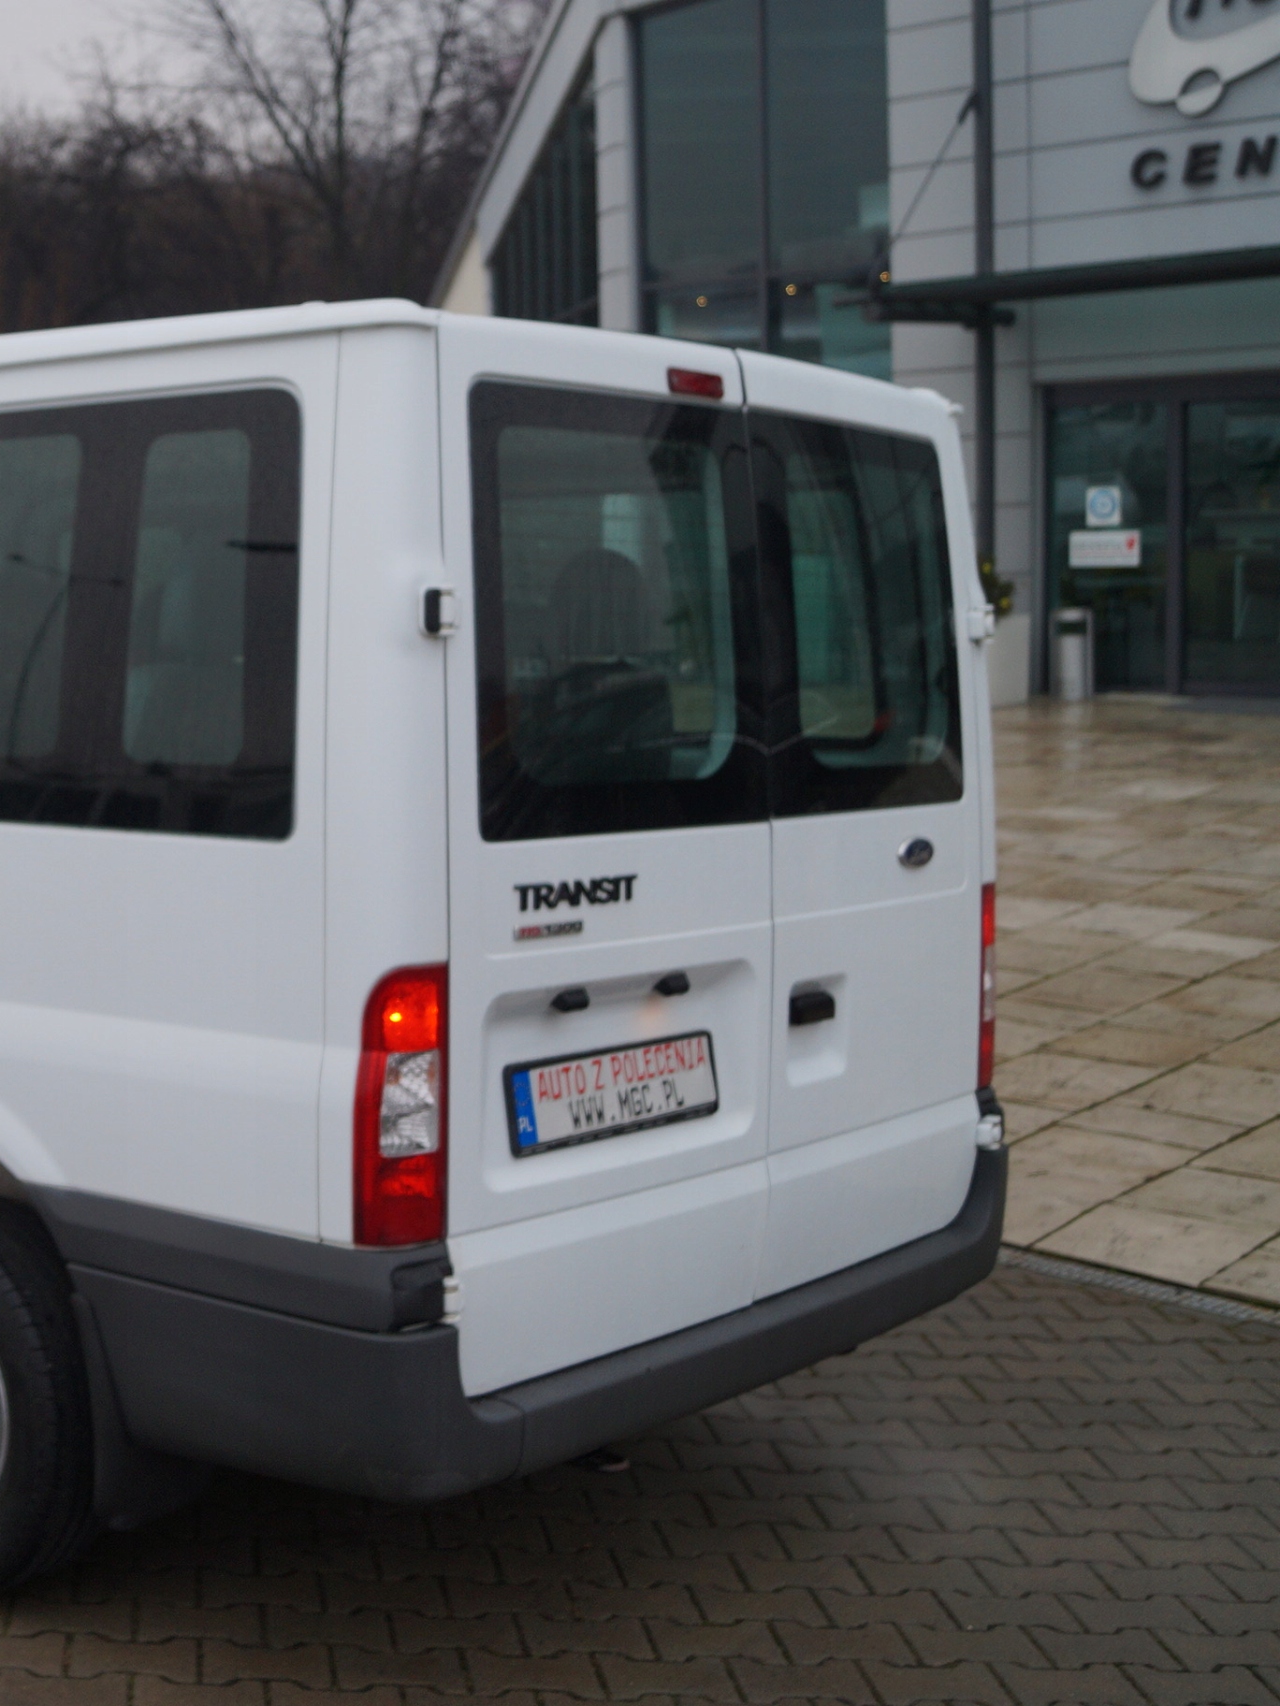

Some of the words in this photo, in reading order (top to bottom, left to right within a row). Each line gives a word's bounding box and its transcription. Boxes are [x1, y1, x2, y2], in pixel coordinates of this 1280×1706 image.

[513, 874, 638, 912] TRANSIT
[537, 1063, 587, 1102] AUTO
[591, 1057, 605, 1091] Z
[610, 1037, 705, 1086] POLECENIA
[518, 1116, 534, 1134] PL
